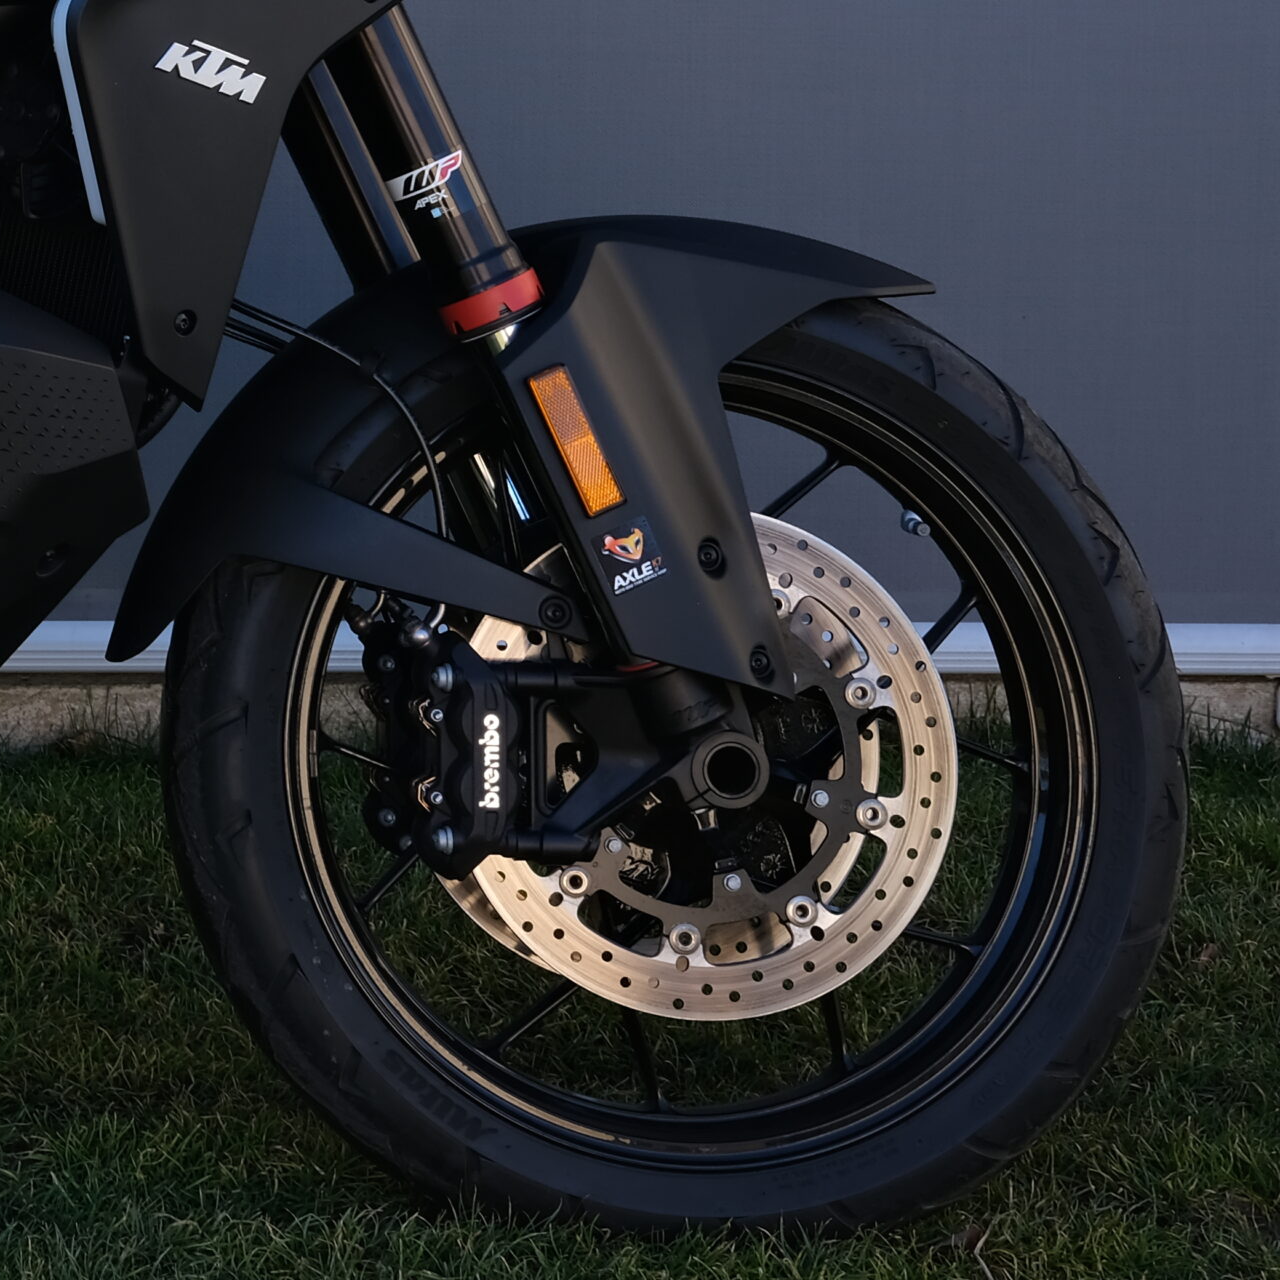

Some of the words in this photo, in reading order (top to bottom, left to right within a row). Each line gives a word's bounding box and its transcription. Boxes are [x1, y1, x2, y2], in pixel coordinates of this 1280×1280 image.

[154, 38, 267, 105] KTM
[413, 188, 449, 211] APEX
[613, 560, 654, 591] AXLE
[478, 713, 500, 809] brembo
